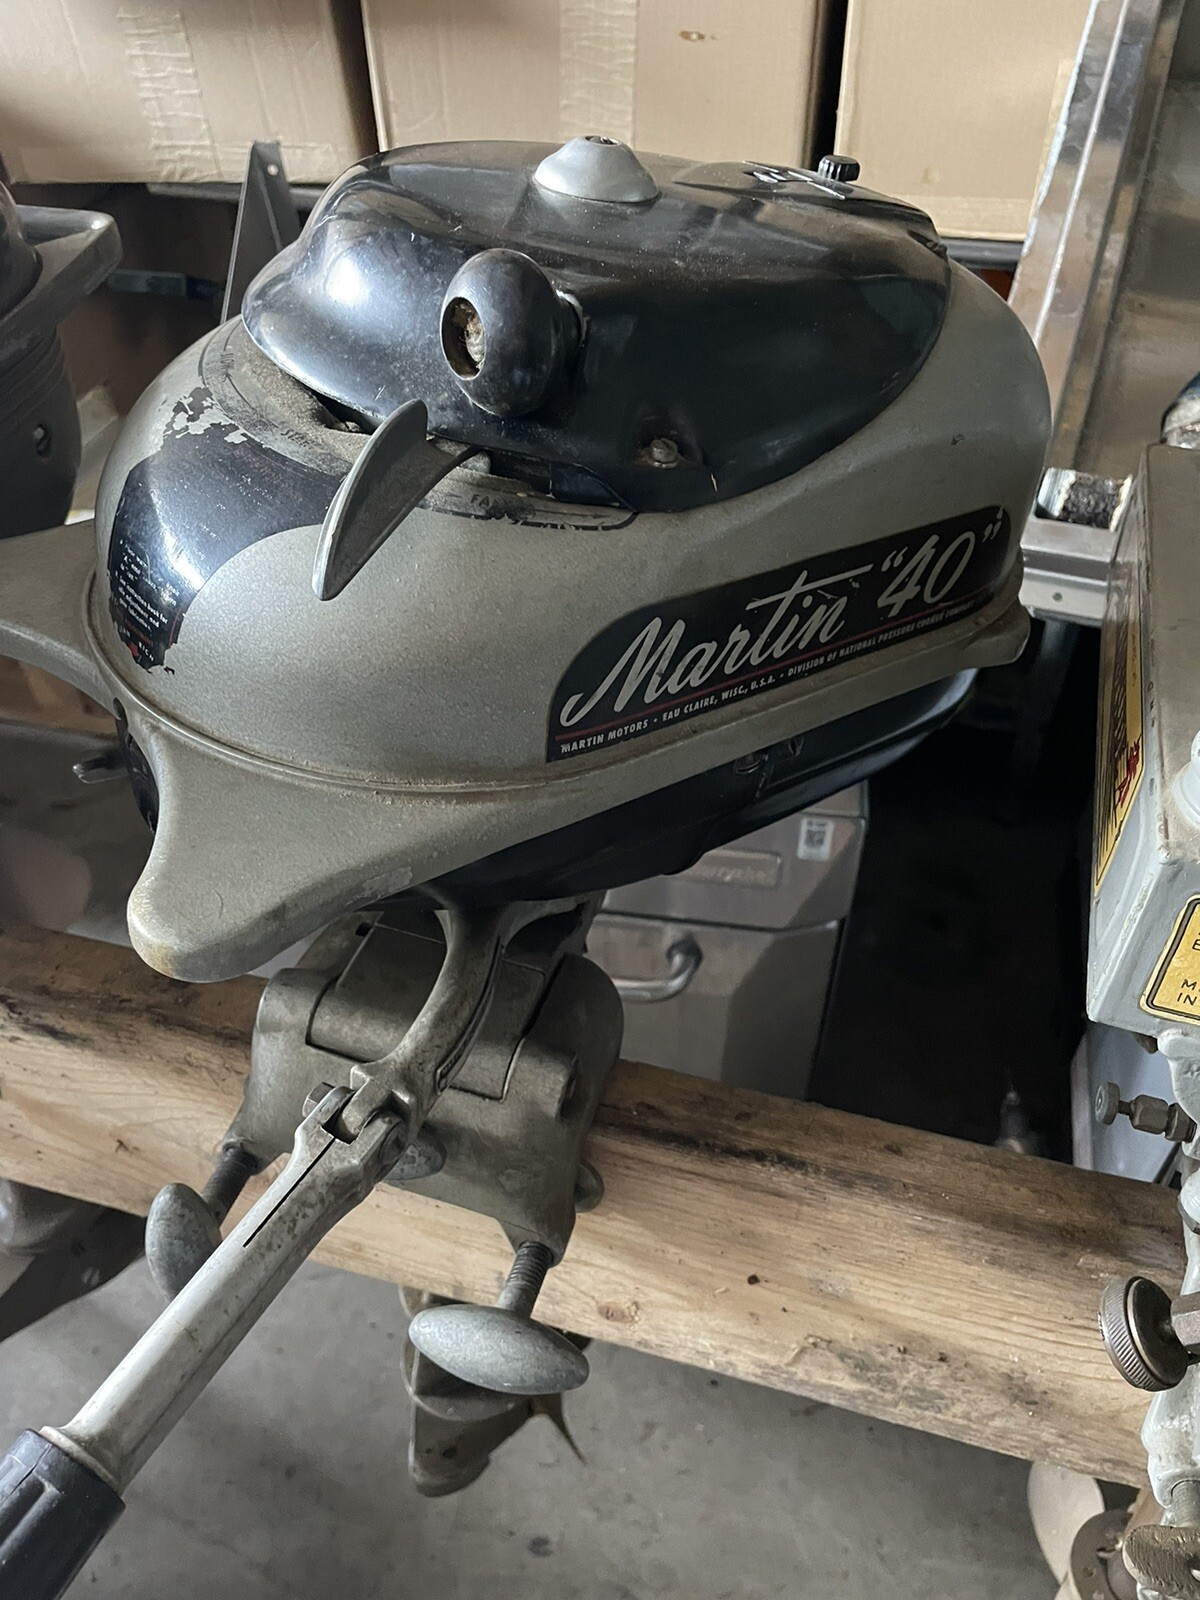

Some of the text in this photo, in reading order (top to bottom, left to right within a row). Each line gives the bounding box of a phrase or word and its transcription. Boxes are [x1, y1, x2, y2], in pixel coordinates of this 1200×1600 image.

[559, 564, 874, 728] Martin
[560, 735, 604, 753] MARTIN
[607, 719, 649, 740] MOTORS
[662, 708, 681, 722] EAU
[683, 694, 718, 714] CLAIRE,
[750, 675, 776, 690] U.S.A.
[788, 656, 825, 676] DIVISION
[827, 650, 838, 662] OF
[839, 638, 878, 658] NATIONAL
[877, 623, 916, 644] PRESSURE
[916, 612, 945, 630] COOKER
